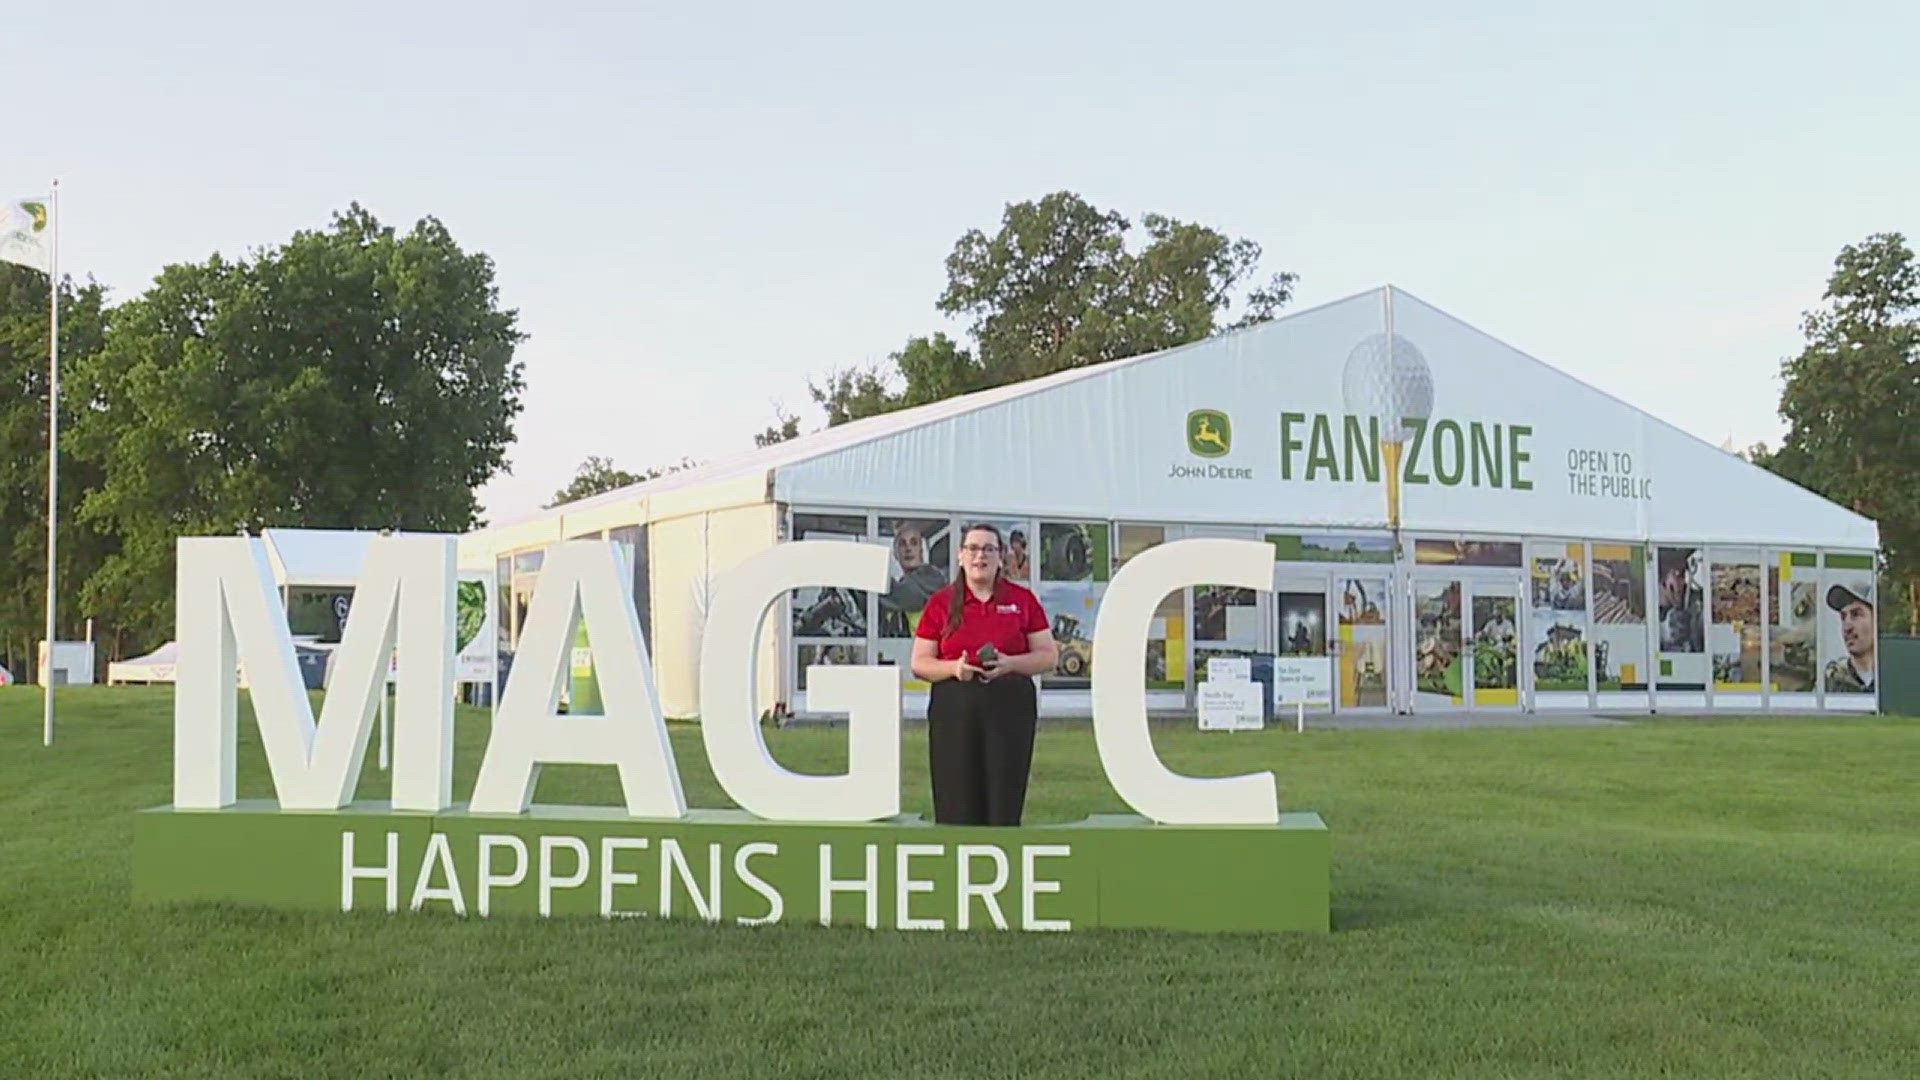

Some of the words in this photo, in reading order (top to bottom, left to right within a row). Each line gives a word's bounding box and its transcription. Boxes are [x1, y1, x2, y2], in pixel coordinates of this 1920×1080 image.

[1280, 412, 1380, 483] FAN
[1401, 416, 1534, 491] ZONE
[1567, 448, 1608, 472] OPEN
[1612, 451, 1632, 475] TO
[1167, 463, 1206, 478] JOHN
[1208, 464, 1253, 480] DEERE
[1568, 472, 1597, 496] THE
[1601, 475, 1652, 501] PUBLIC
[341, 831, 784, 926] HAPPENS
[818, 843, 1072, 932] HERE
